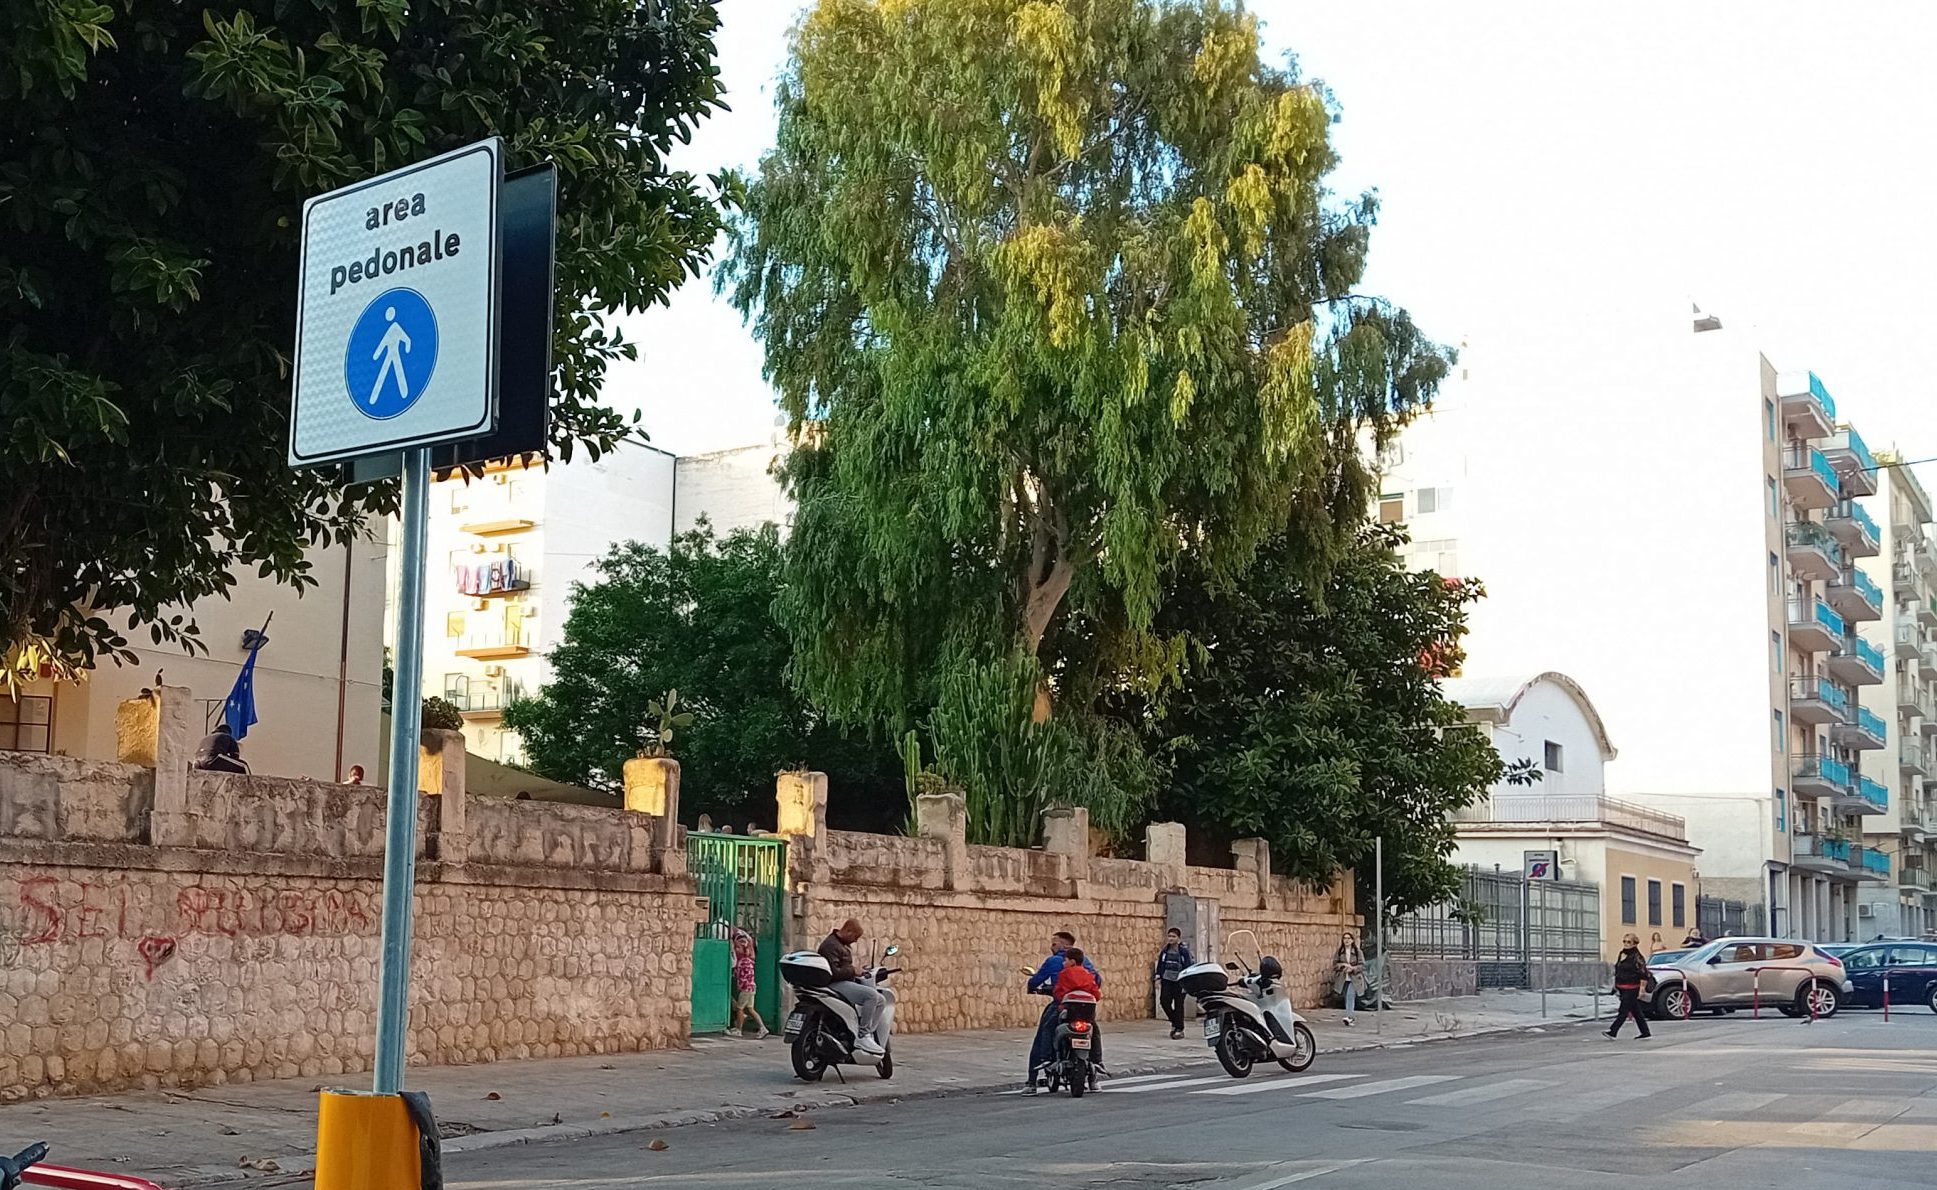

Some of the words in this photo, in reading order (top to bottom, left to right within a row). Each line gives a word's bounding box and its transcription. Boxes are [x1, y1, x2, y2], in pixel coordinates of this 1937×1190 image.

[366, 193, 426, 230] area
[331, 229, 460, 295] pedonale
[20, 874, 130, 945] SEI
